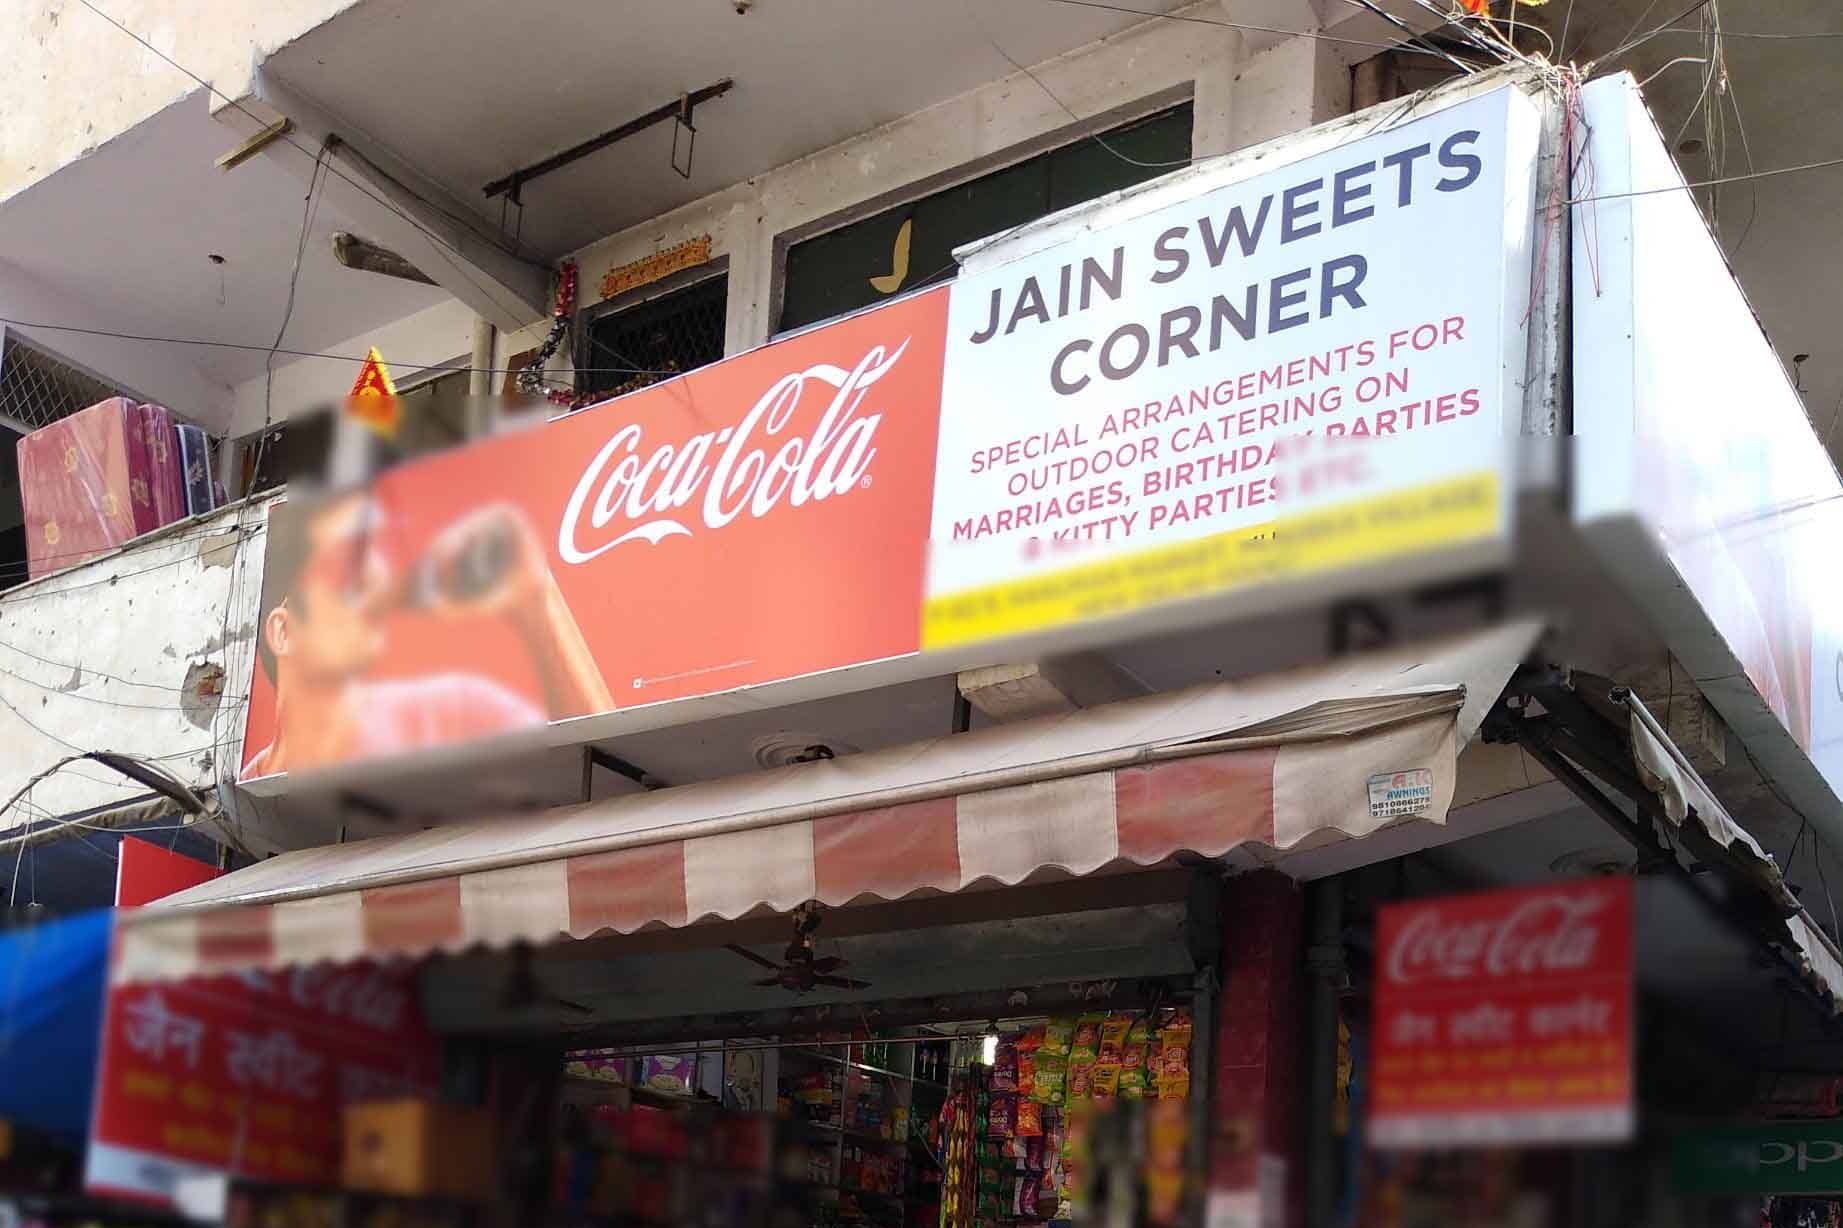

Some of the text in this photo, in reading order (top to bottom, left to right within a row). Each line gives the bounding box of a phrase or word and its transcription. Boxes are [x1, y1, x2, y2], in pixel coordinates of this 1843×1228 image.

[969, 129, 1483, 346] JAIN SWEETS
[969, 316, 1467, 475] SPECIAL ARRANGEMENTS FOR
[1049, 254, 1369, 396] CORNER
[558, 335, 912, 565] Coca-Cola
[952, 480, 1132, 542] MARRIAGES,
[1142, 425, 1313, 497] BIRTHD
[1007, 367, 1411, 497] OUTDOOR CATERING ON
